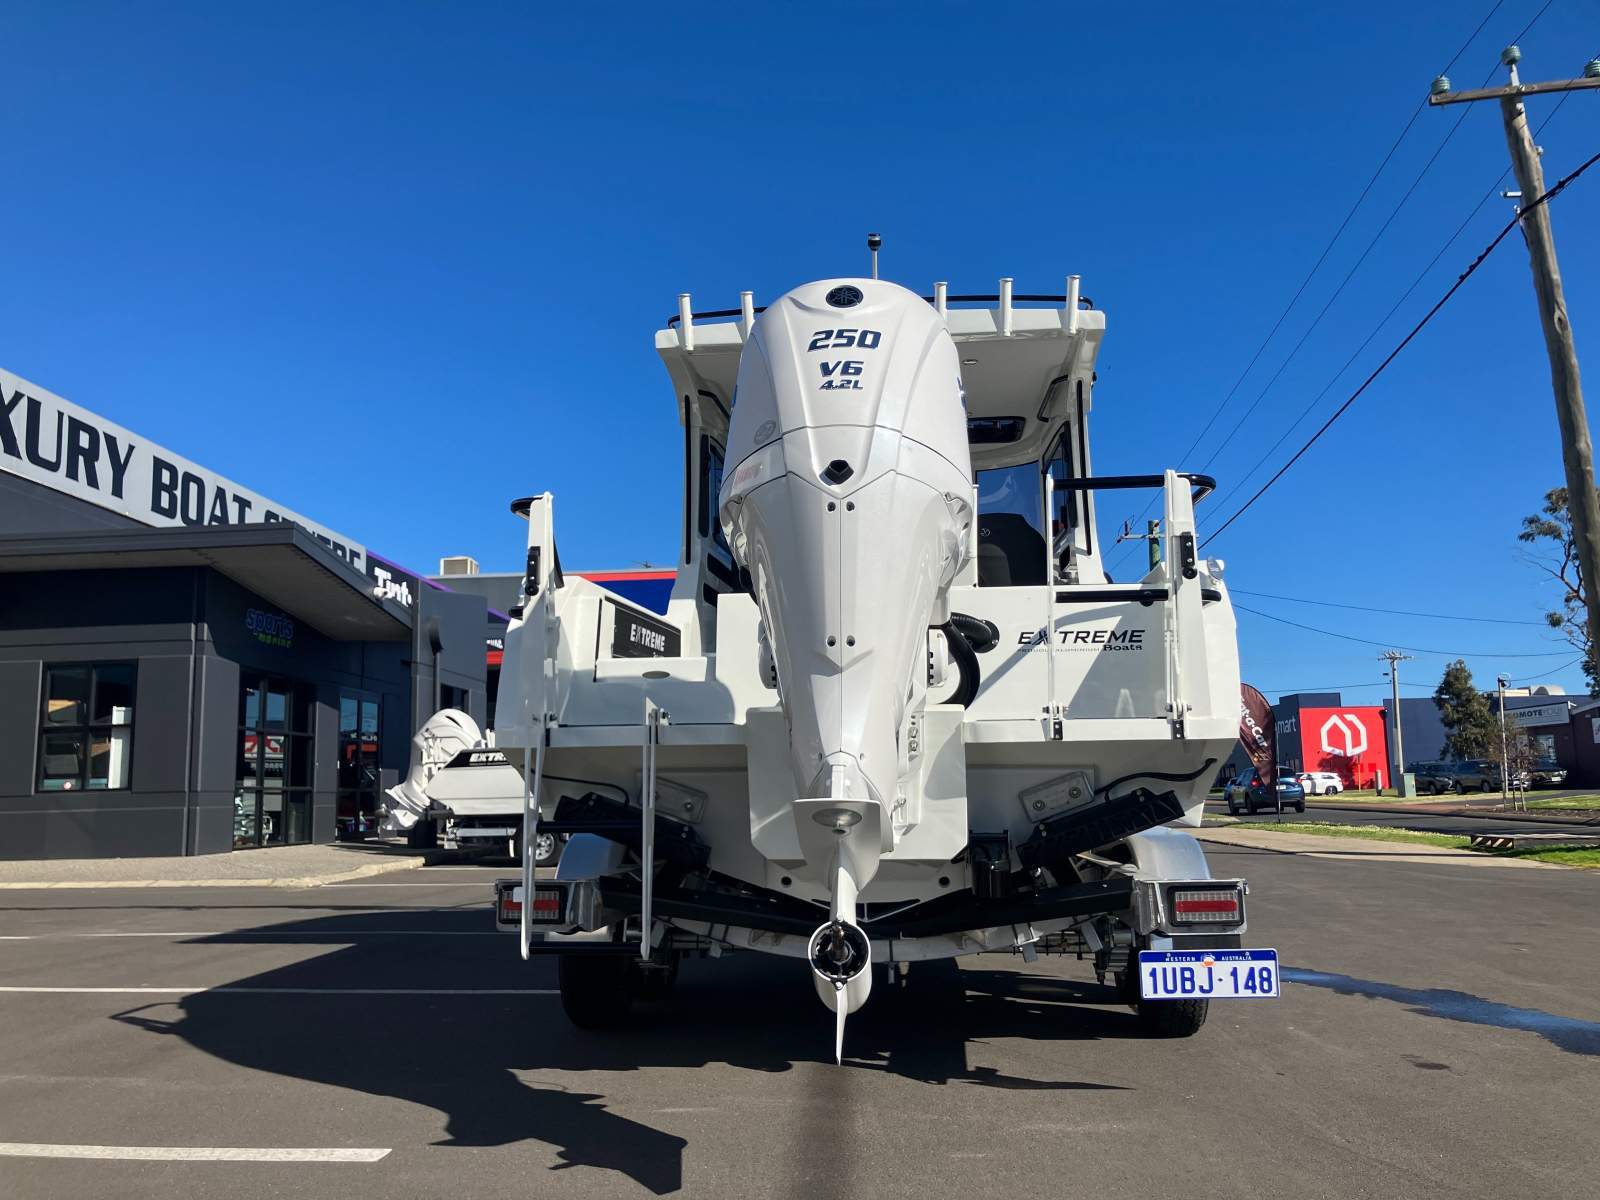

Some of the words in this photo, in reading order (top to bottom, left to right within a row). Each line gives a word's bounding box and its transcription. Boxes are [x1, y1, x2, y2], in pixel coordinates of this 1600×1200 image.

[807, 329, 881, 352] 250
[820, 360, 864, 377] V6
[819, 380, 863, 390] 4.2L
[151, 455, 252, 526] BOAT
[630, 623, 666, 652] EXTREME
[1275, 716, 1297, 734] mart
